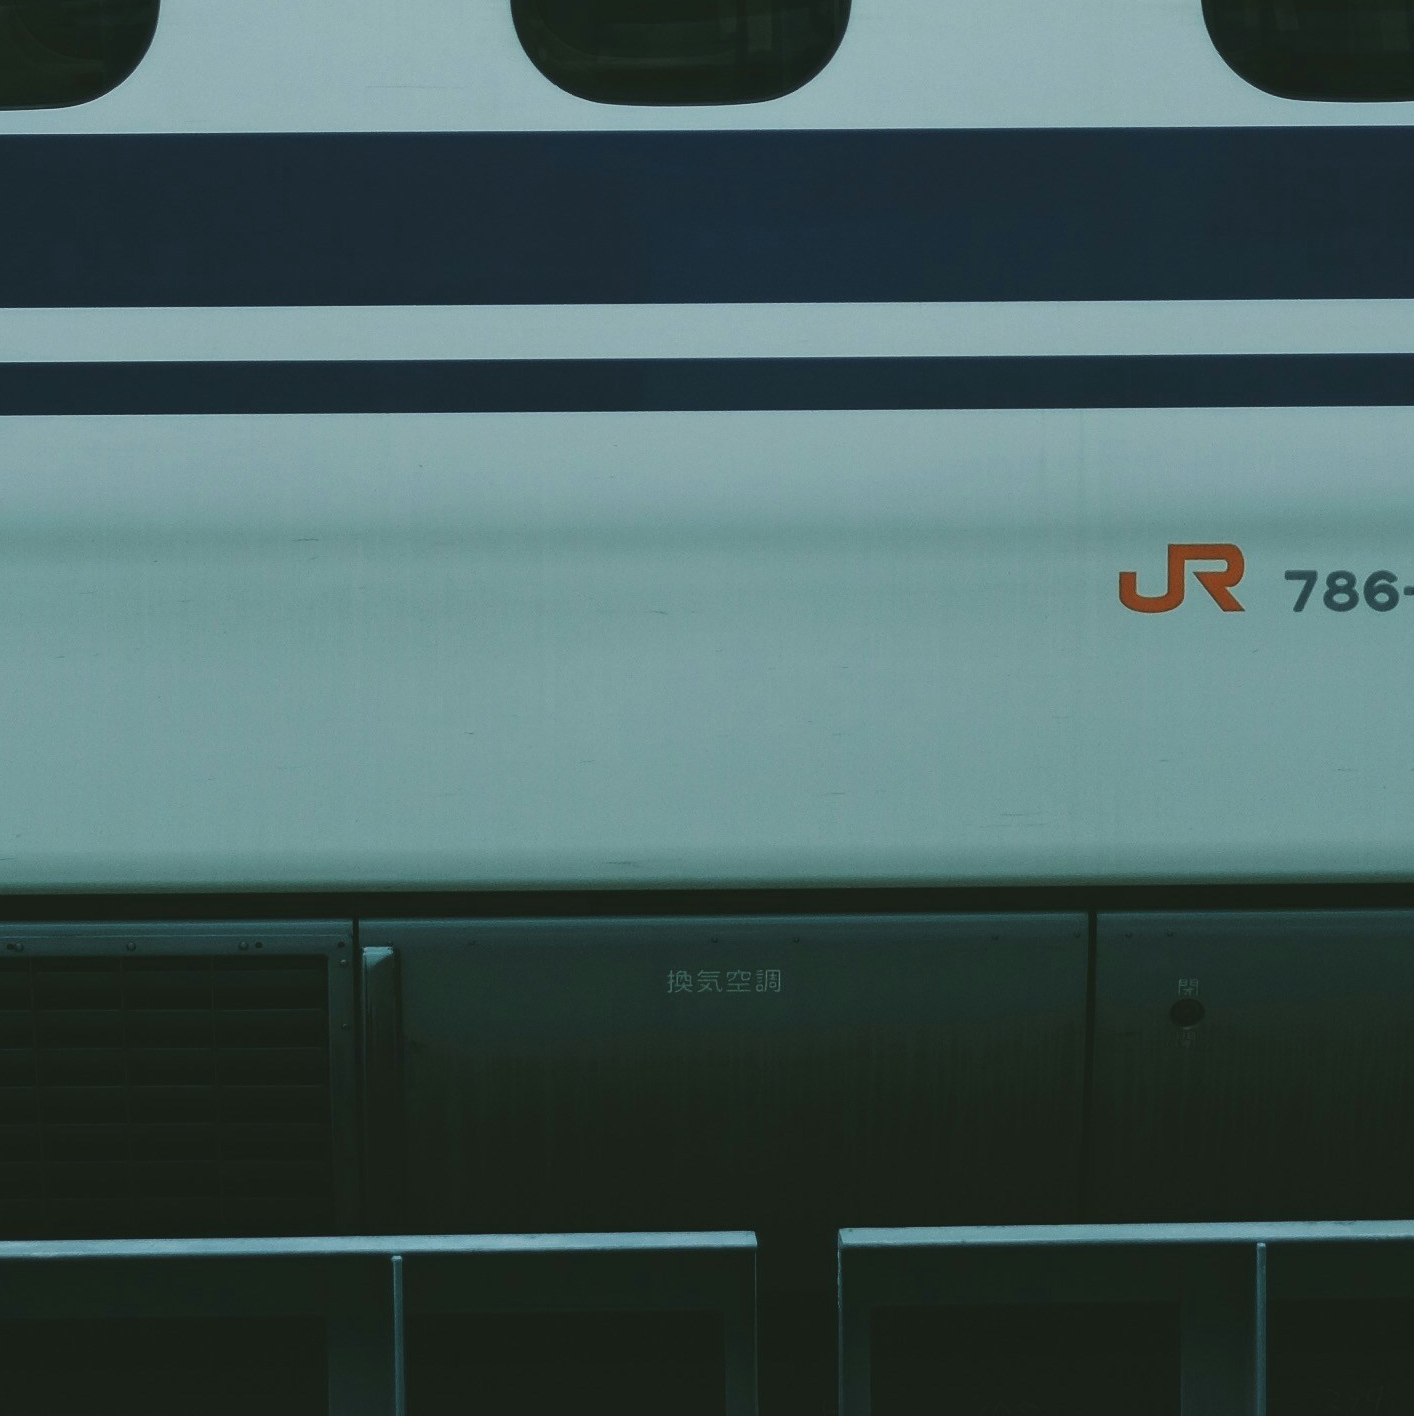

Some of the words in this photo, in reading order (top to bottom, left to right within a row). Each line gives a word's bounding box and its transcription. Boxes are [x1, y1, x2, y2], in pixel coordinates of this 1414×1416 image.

[1118, 543, 1246, 614] JR
[666, 968, 782, 994] 換気空調
